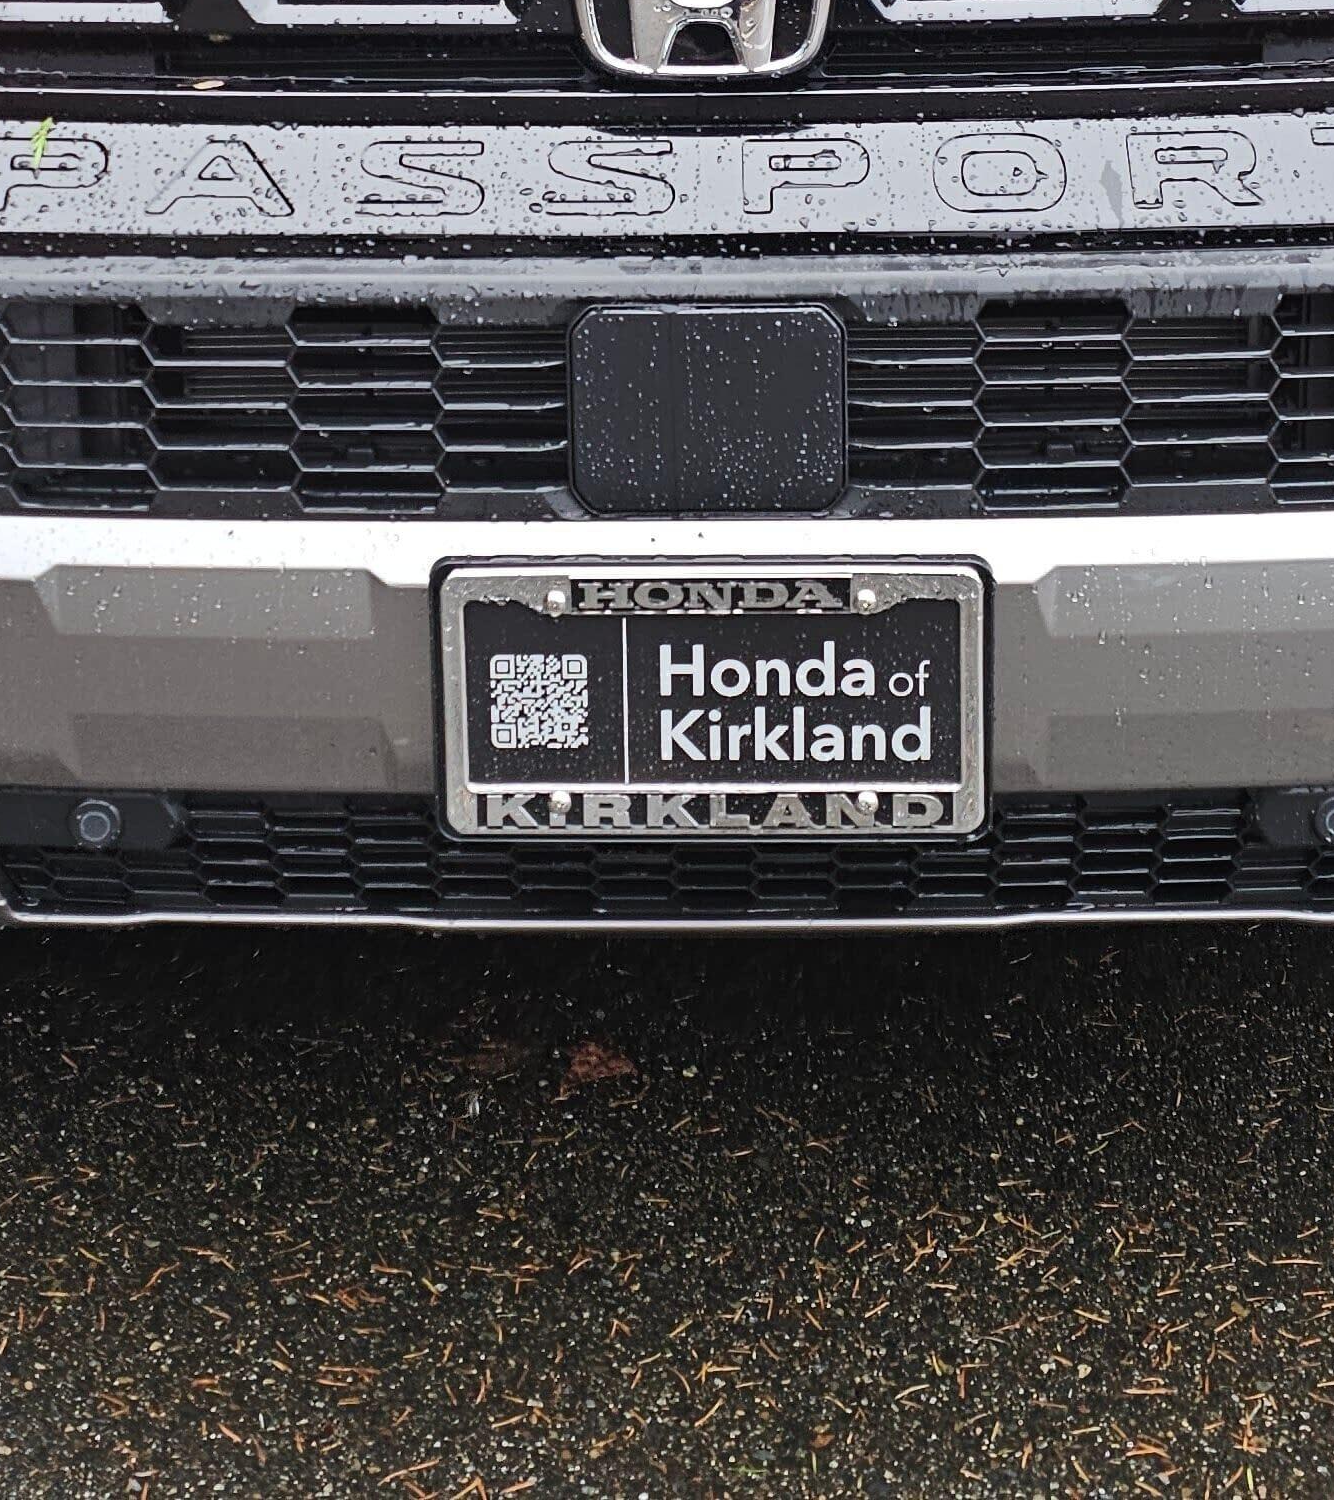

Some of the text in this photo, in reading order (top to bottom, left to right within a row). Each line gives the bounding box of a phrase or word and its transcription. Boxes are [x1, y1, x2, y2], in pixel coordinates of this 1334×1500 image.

[577, 580, 842, 612] HONDA
[658, 640, 931, 698] Honda of
[658, 707, 932, 762] Kirkland
